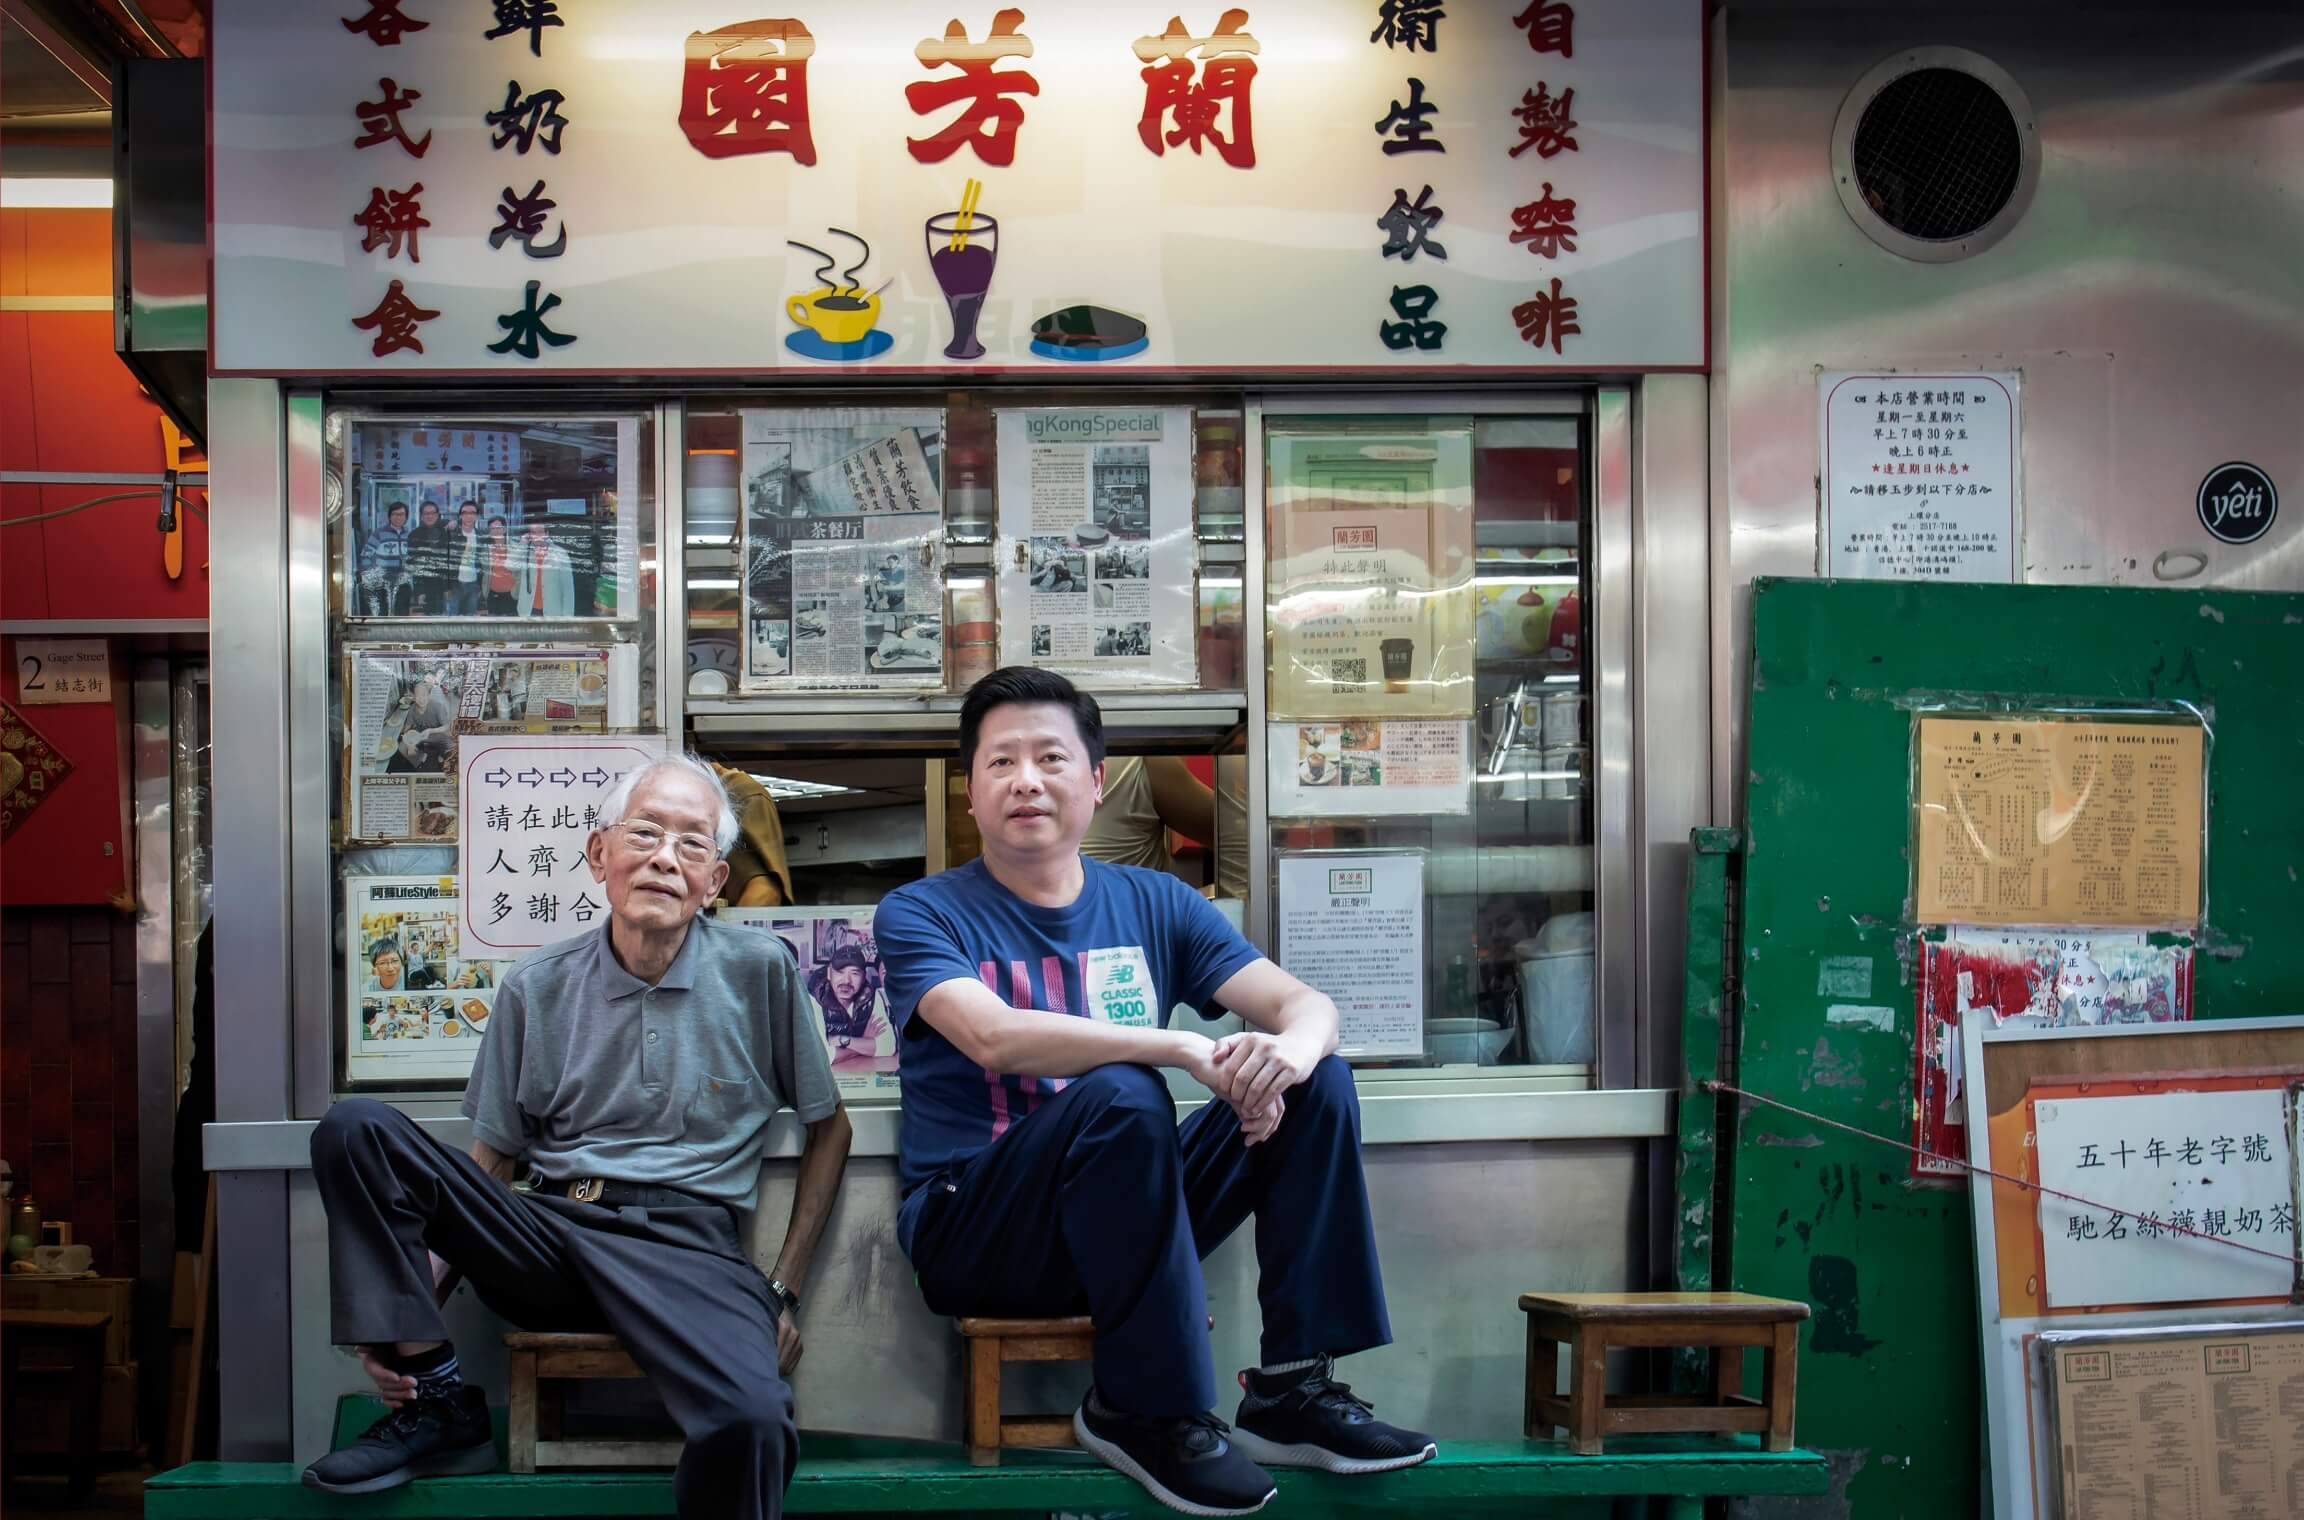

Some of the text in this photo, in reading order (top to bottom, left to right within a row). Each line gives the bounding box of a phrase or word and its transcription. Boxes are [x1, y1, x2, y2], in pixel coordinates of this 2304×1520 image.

[22, 651, 105, 690] 2 Gage Street
[55, 677, 104, 693] 結志街
[1101, 986, 1144, 1001] CLASSIC
[1104, 1000, 1146, 1019] 1300
[2075, 1133, 2273, 1168] 五十年老字號
